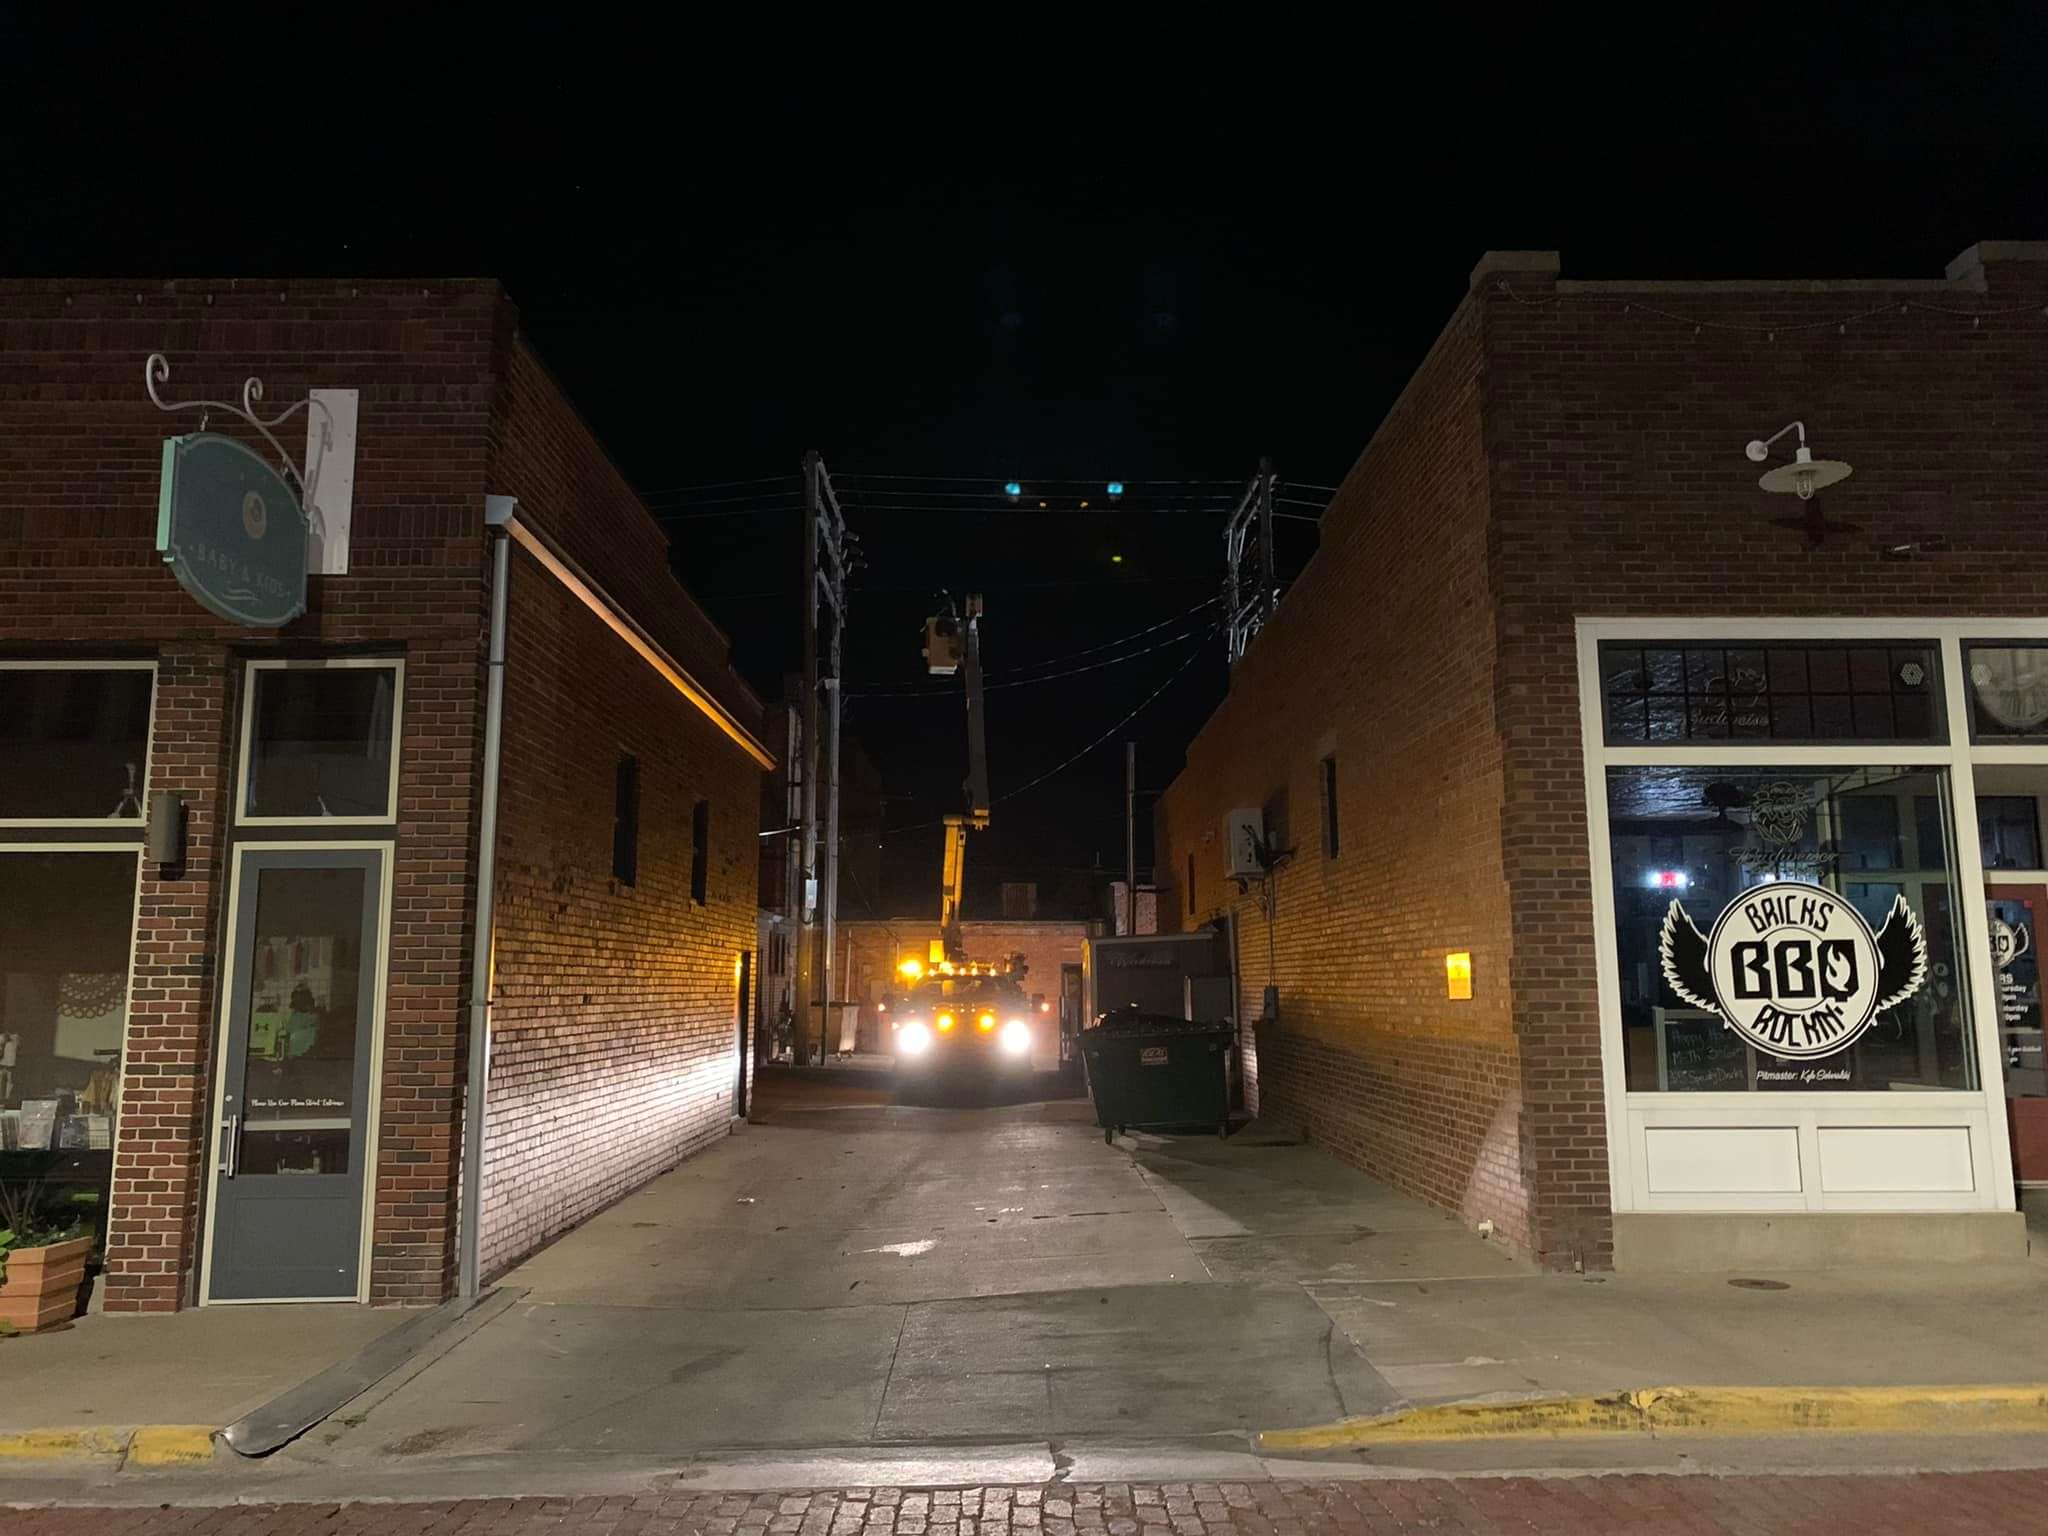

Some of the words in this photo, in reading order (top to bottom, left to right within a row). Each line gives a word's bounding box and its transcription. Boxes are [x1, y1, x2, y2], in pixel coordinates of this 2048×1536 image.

[1745, 895, 1834, 934] BRICKS
[1730, 939, 1860, 1002] BBQ
[1756, 1069, 1798, 1081] Pitmaster:
